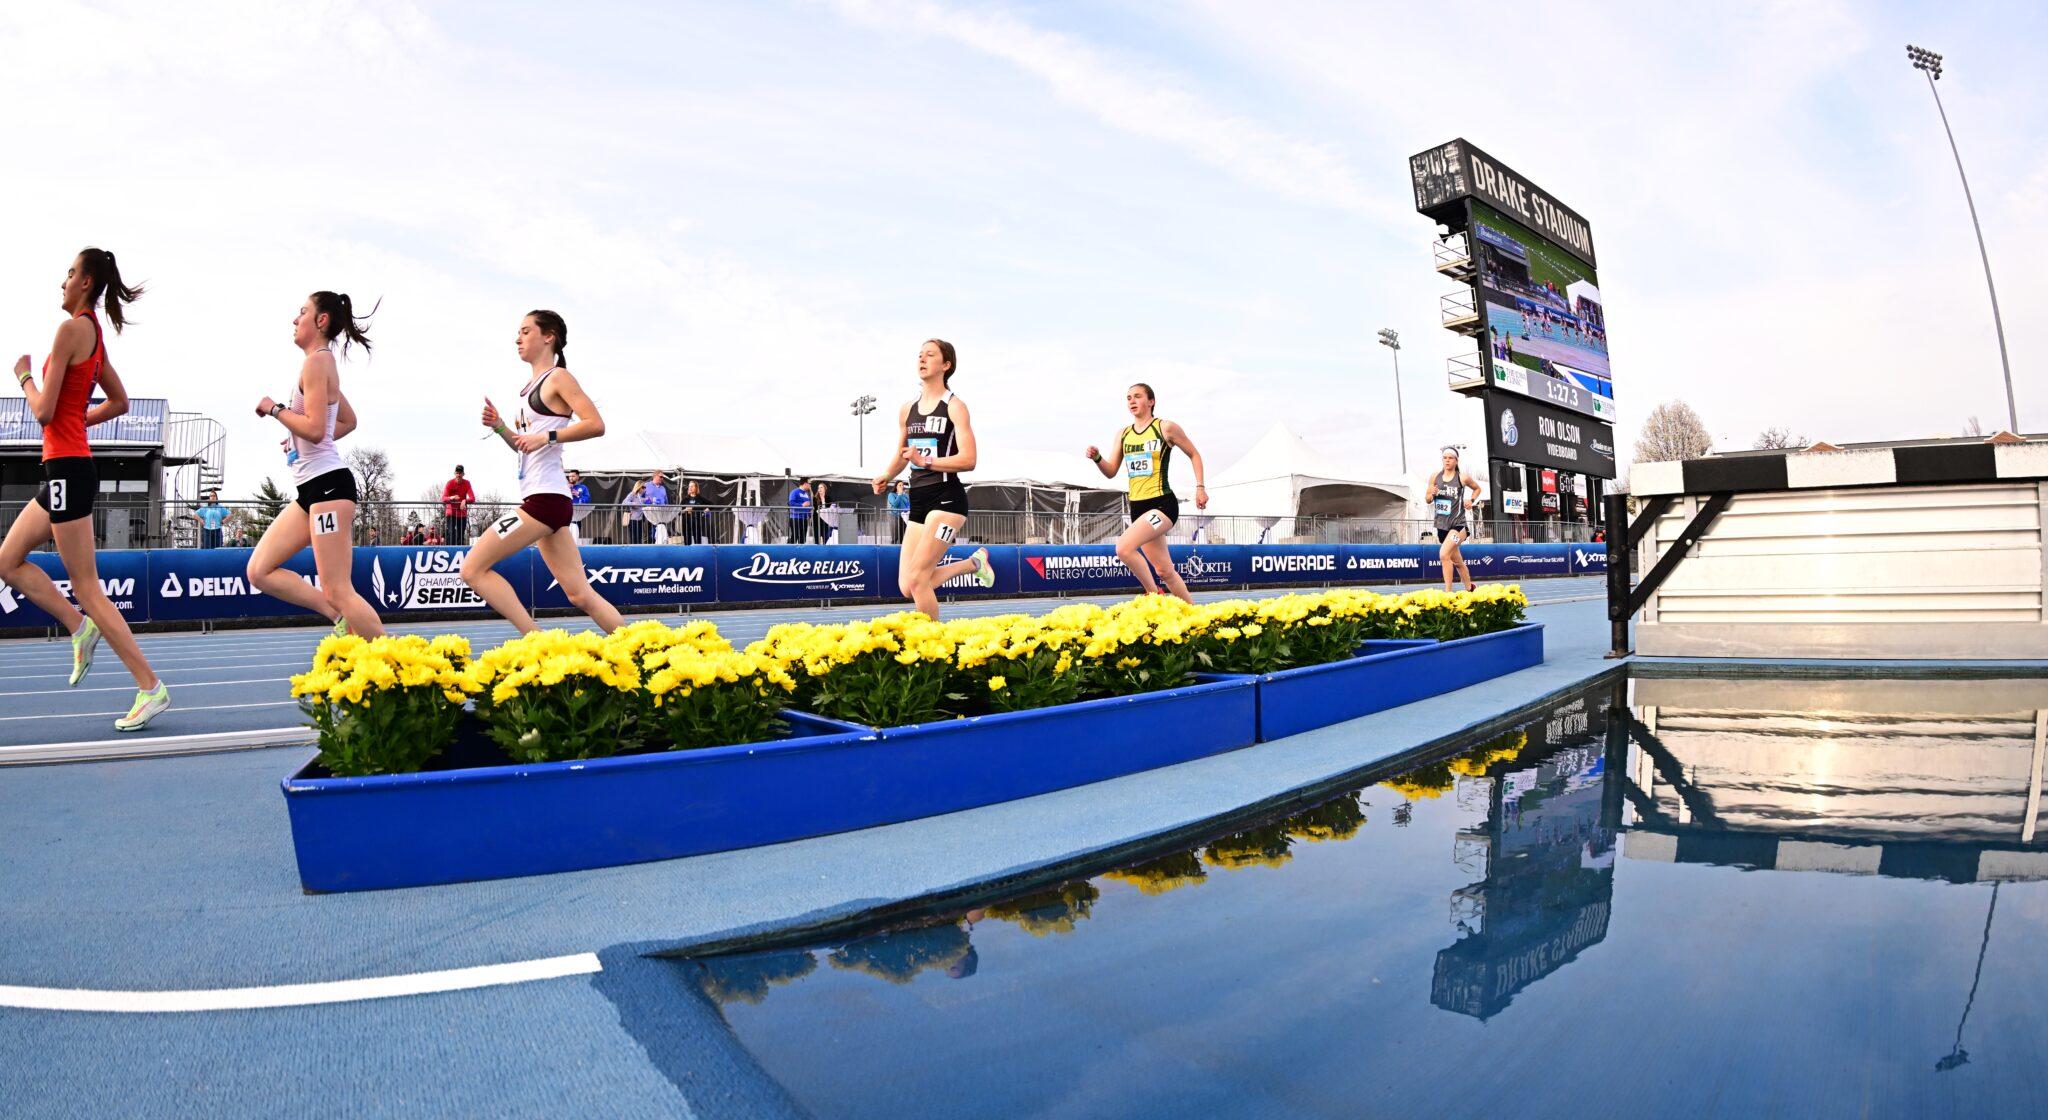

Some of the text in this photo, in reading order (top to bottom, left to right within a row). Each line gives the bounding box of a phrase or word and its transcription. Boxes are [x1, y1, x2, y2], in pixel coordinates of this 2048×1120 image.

[1471, 154, 1591, 256] DRAKE STADIUM
[1546, 380, 1579, 406] 1:27.3
[930, 417, 943, 432] 11
[1539, 416, 1581, 444] RON OLSON
[1147, 439, 1158, 451] 17
[1546, 443, 1578, 460] VIDEOBOARD
[1130, 460, 1148, 471] 425
[53, 481, 62, 510] 3
[1512, 499, 1523, 507] EMC
[317, 512, 336, 533] 14
[498, 516, 519, 534] 4
[1149, 513, 1161, 526] 17
[940, 525, 954, 542] 11
[749, 552, 860, 576] Drake RELAYS
[1252, 555, 1335, 572] POWERADE
[1360, 558, 1419, 569] DELTA DENTAL
[419, 577, 467, 587] CHAMPIO
[587, 566, 704, 583] XTREAM
[1046, 567, 1136, 580] ENERGY COMPAN
[189, 576, 246, 597] DELTA
[658, 584, 701, 593] Mediacom
